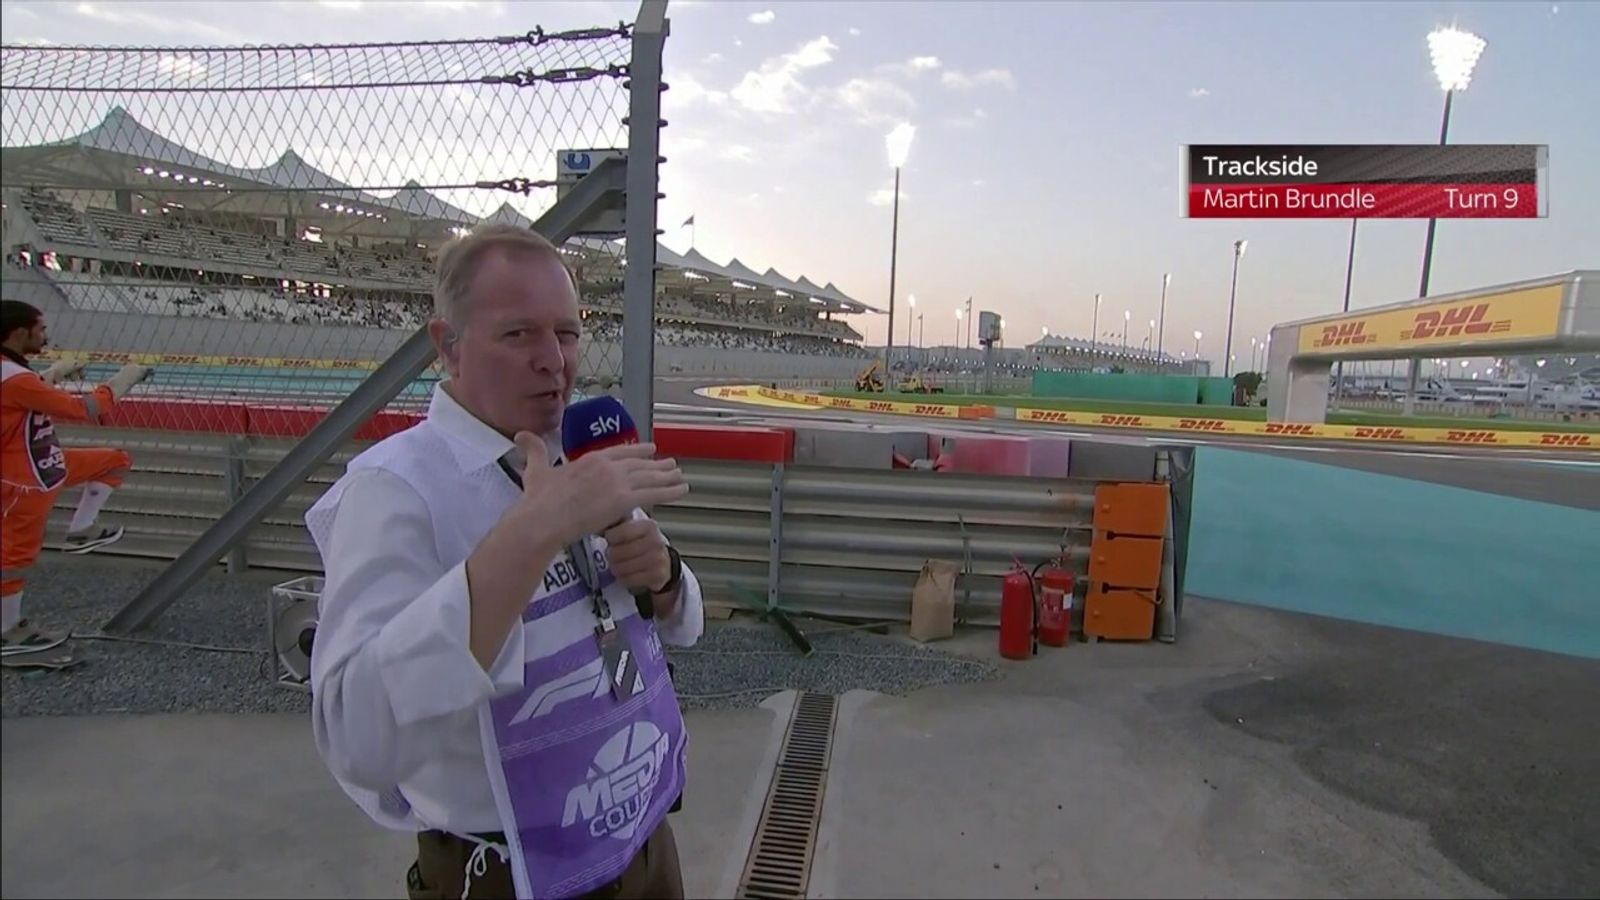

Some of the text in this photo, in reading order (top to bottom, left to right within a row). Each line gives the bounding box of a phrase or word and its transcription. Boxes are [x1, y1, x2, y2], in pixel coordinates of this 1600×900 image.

[1412, 303, 1493, 339] DHL
[1321, 321, 1367, 347] DHL
[869, 401, 893, 412] DHL
[915, 405, 945, 415] DHL
[1031, 410, 1069, 422] DHL
[1100, 414, 1143, 426] DHL
[589, 414, 620, 437] sky
[1178, 419, 1226, 431] DHL
[1265, 423, 1314, 435] DHL
[1354, 427, 1405, 440] DHL
[1447, 431, 1498, 443] DHL
[1540, 434, 1592, 446] DHL
